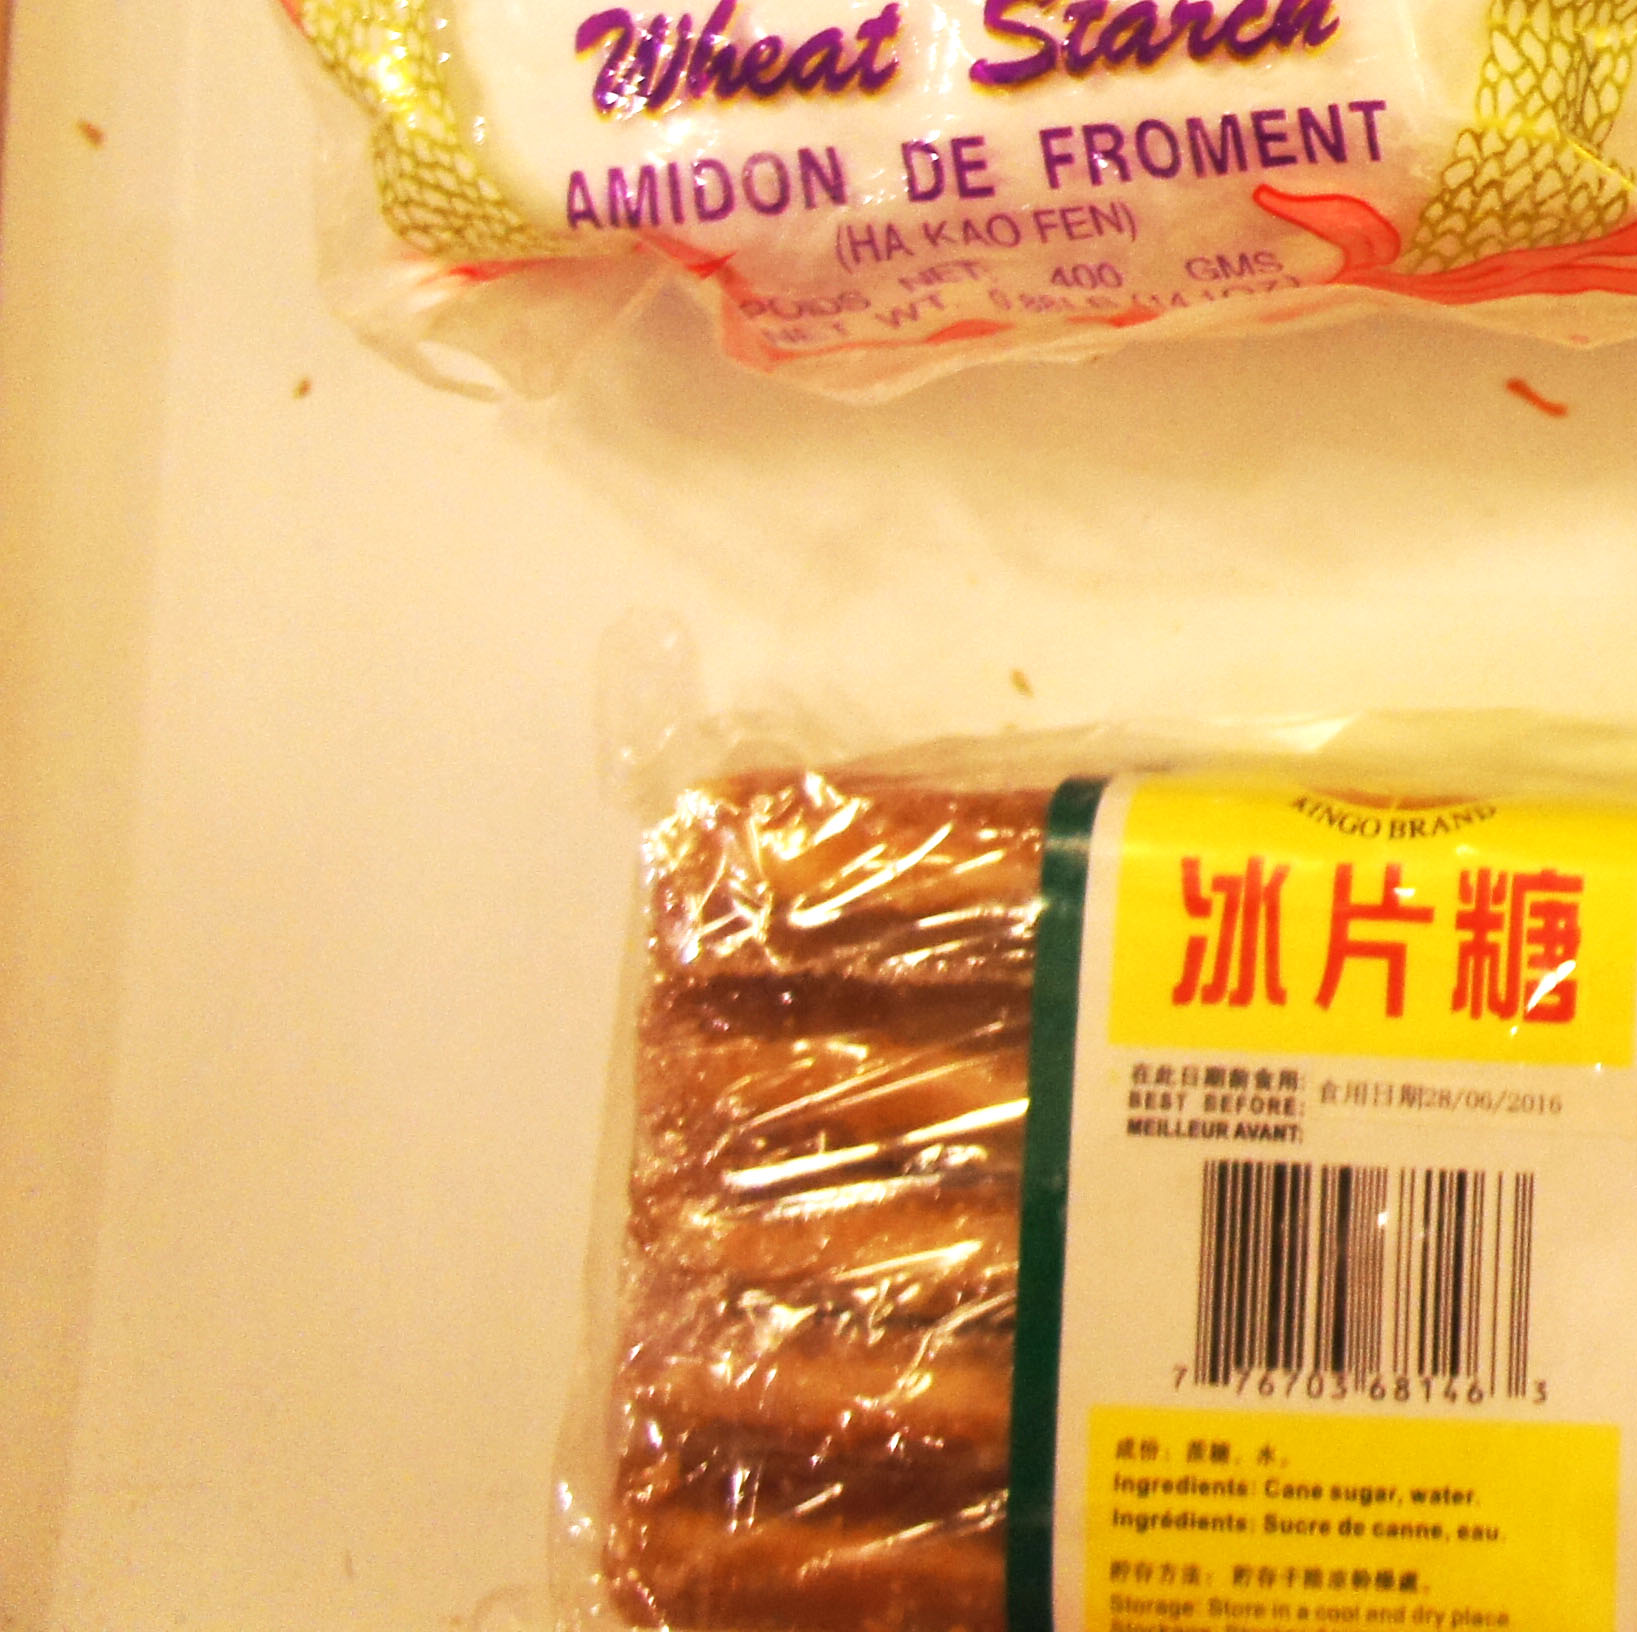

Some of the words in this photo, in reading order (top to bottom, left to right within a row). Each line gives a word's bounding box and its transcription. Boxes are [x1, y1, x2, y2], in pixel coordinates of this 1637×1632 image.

[566, 145, 848, 232] AMIDON
[901, 135, 996, 203] DE
[1038, 99, 1387, 191] FROMENT
[834, 222, 914, 271] (HA
[923, 211, 1021, 250] KAO
[1032, 199, 1138, 245] FEN)
[1049, 261, 1124, 291] 400
[1183, 250, 1286, 284] GMS
[1387, 804, 1498, 840] BRAND
[1170, 854, 1585, 1025] 冰片糖
[1127, 1089, 1187, 1113] BEST
[1126, 1117, 1230, 1140] MEILLEUR
[1172, 1363, 1189, 1396] 7
[1264, 1476, 1324, 1502] Cane
[1263, 1512, 1331, 1537] Sucre
[1337, 1515, 1366, 1538] de
